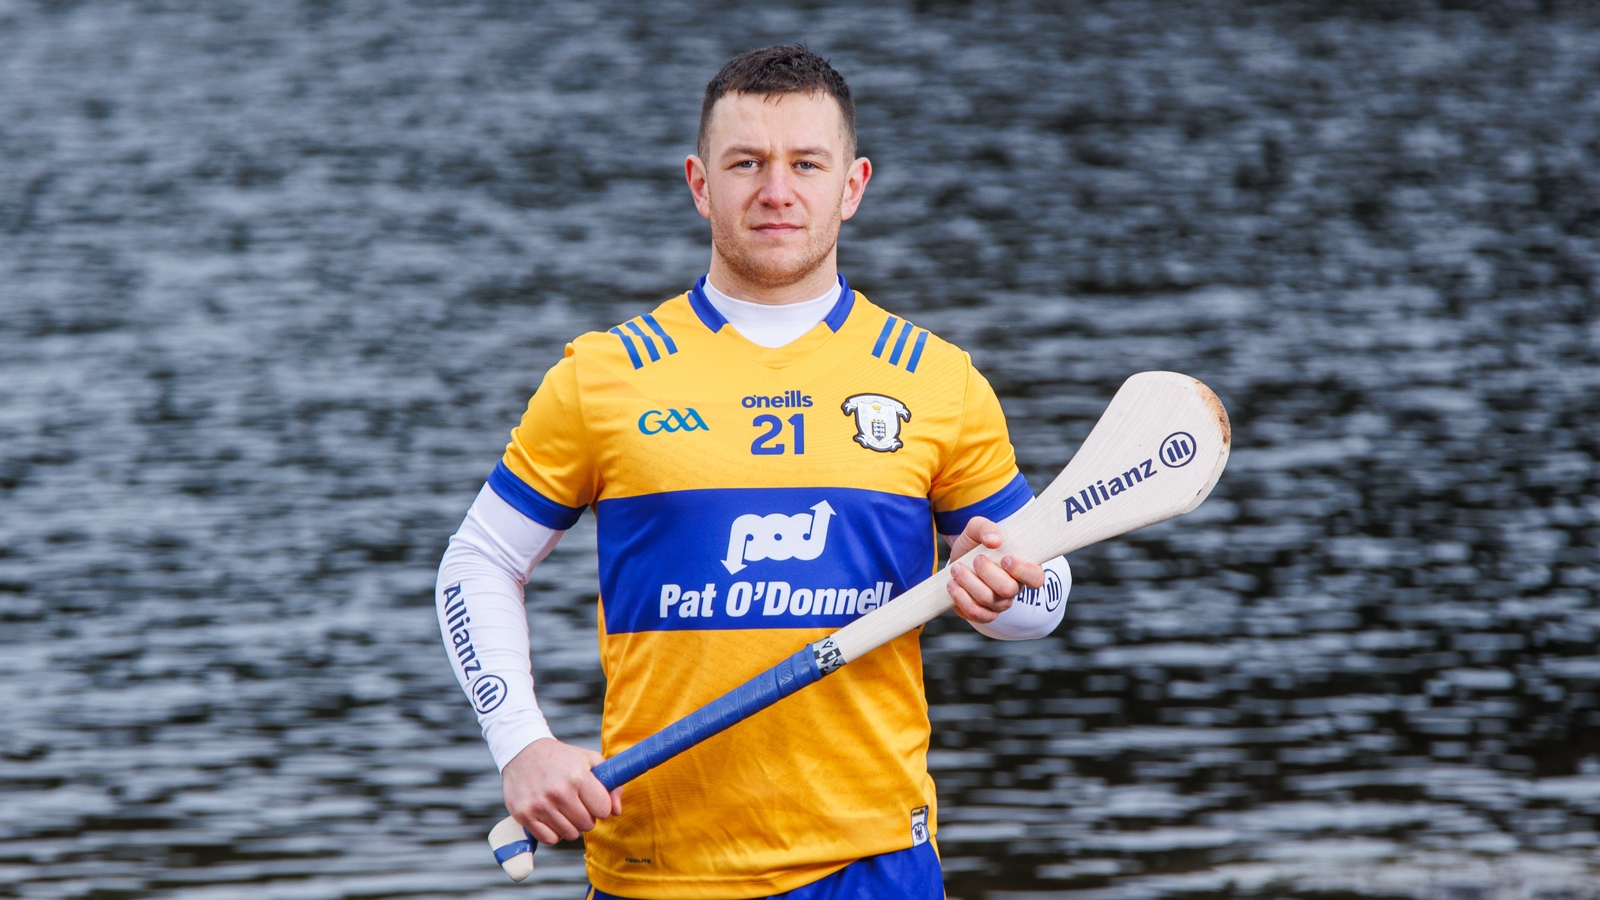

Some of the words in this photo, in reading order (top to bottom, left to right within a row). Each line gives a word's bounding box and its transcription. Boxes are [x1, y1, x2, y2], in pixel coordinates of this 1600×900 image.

[750, 413, 805, 456] 21
[1062, 458, 1158, 523] Allianz
[720, 499, 837, 576] pod
[443, 582, 482, 681] Allianz
[659, 583, 717, 619] Pat
[725, 581, 894, 617] O'Donnell
